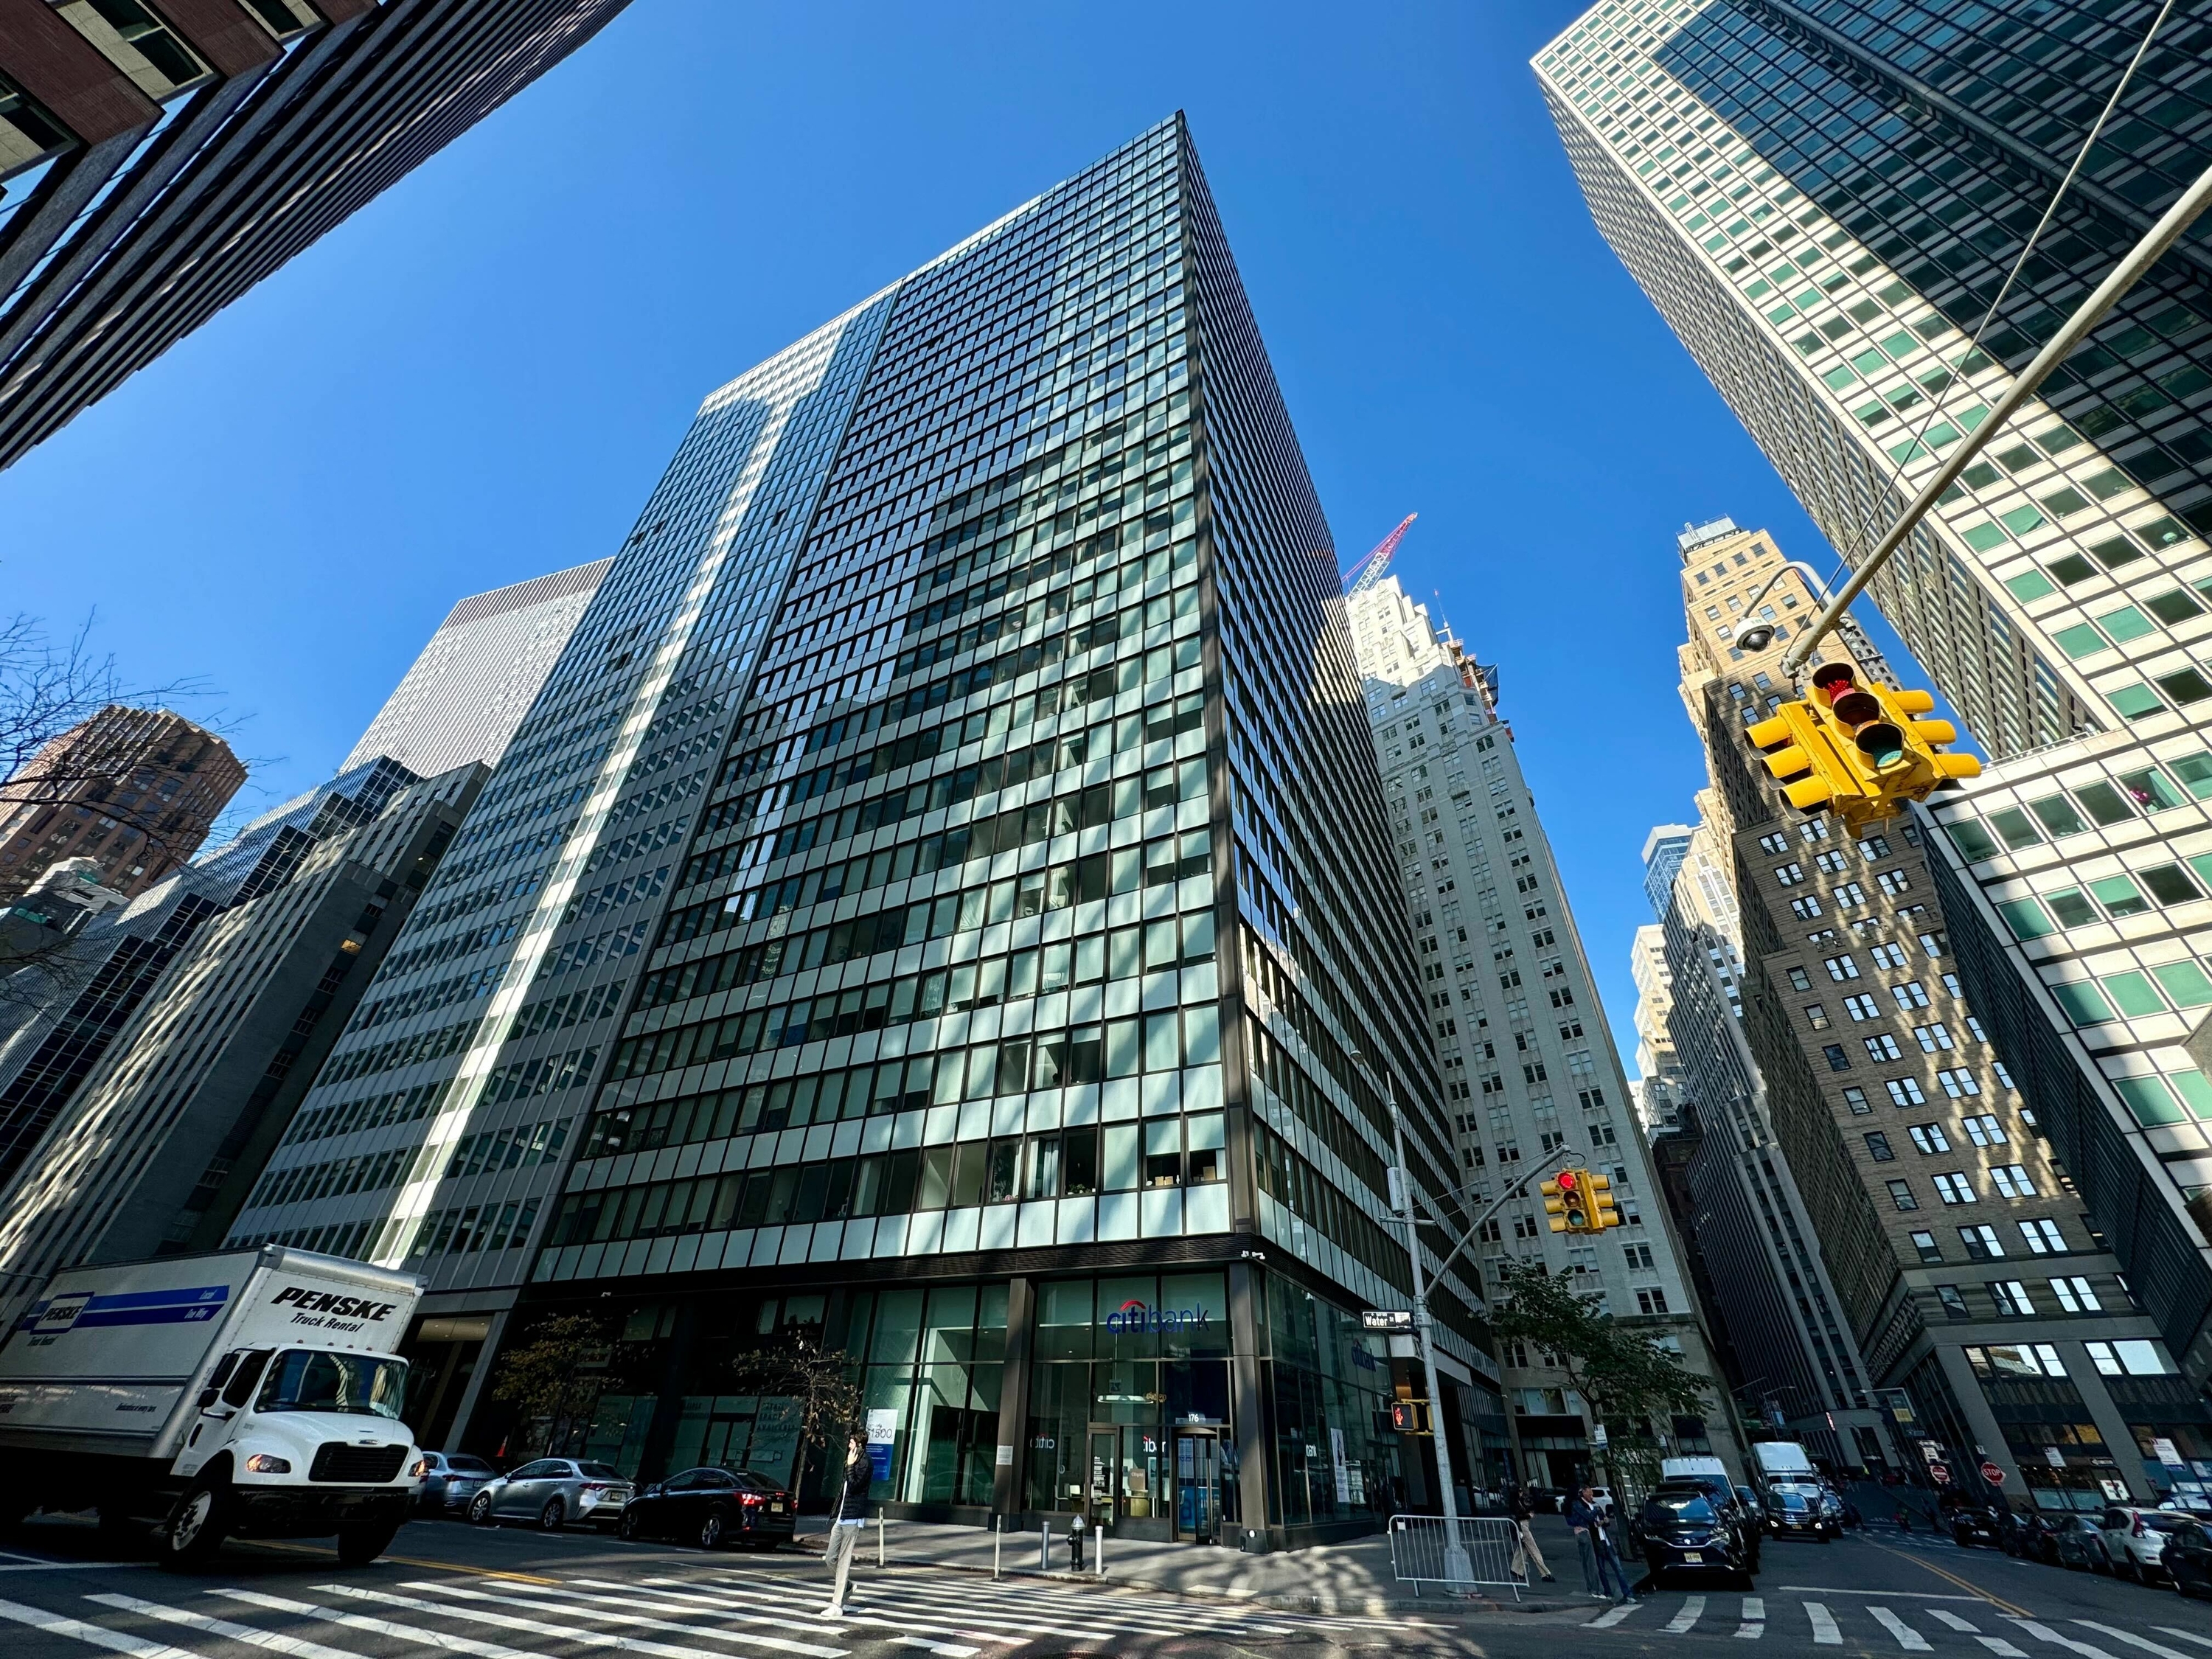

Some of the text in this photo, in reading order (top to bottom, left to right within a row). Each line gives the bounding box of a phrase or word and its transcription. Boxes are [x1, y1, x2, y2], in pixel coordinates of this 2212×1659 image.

[270, 1287, 397, 1321] PENSKE
[41, 1306, 83, 1321] PENSKE
[290, 1312, 365, 1332] Truck Rental
[1106, 1302, 1210, 1335] citibank
[1365, 1315, 1388, 1326] Water
[1188, 1413, 1200, 1422] 176
